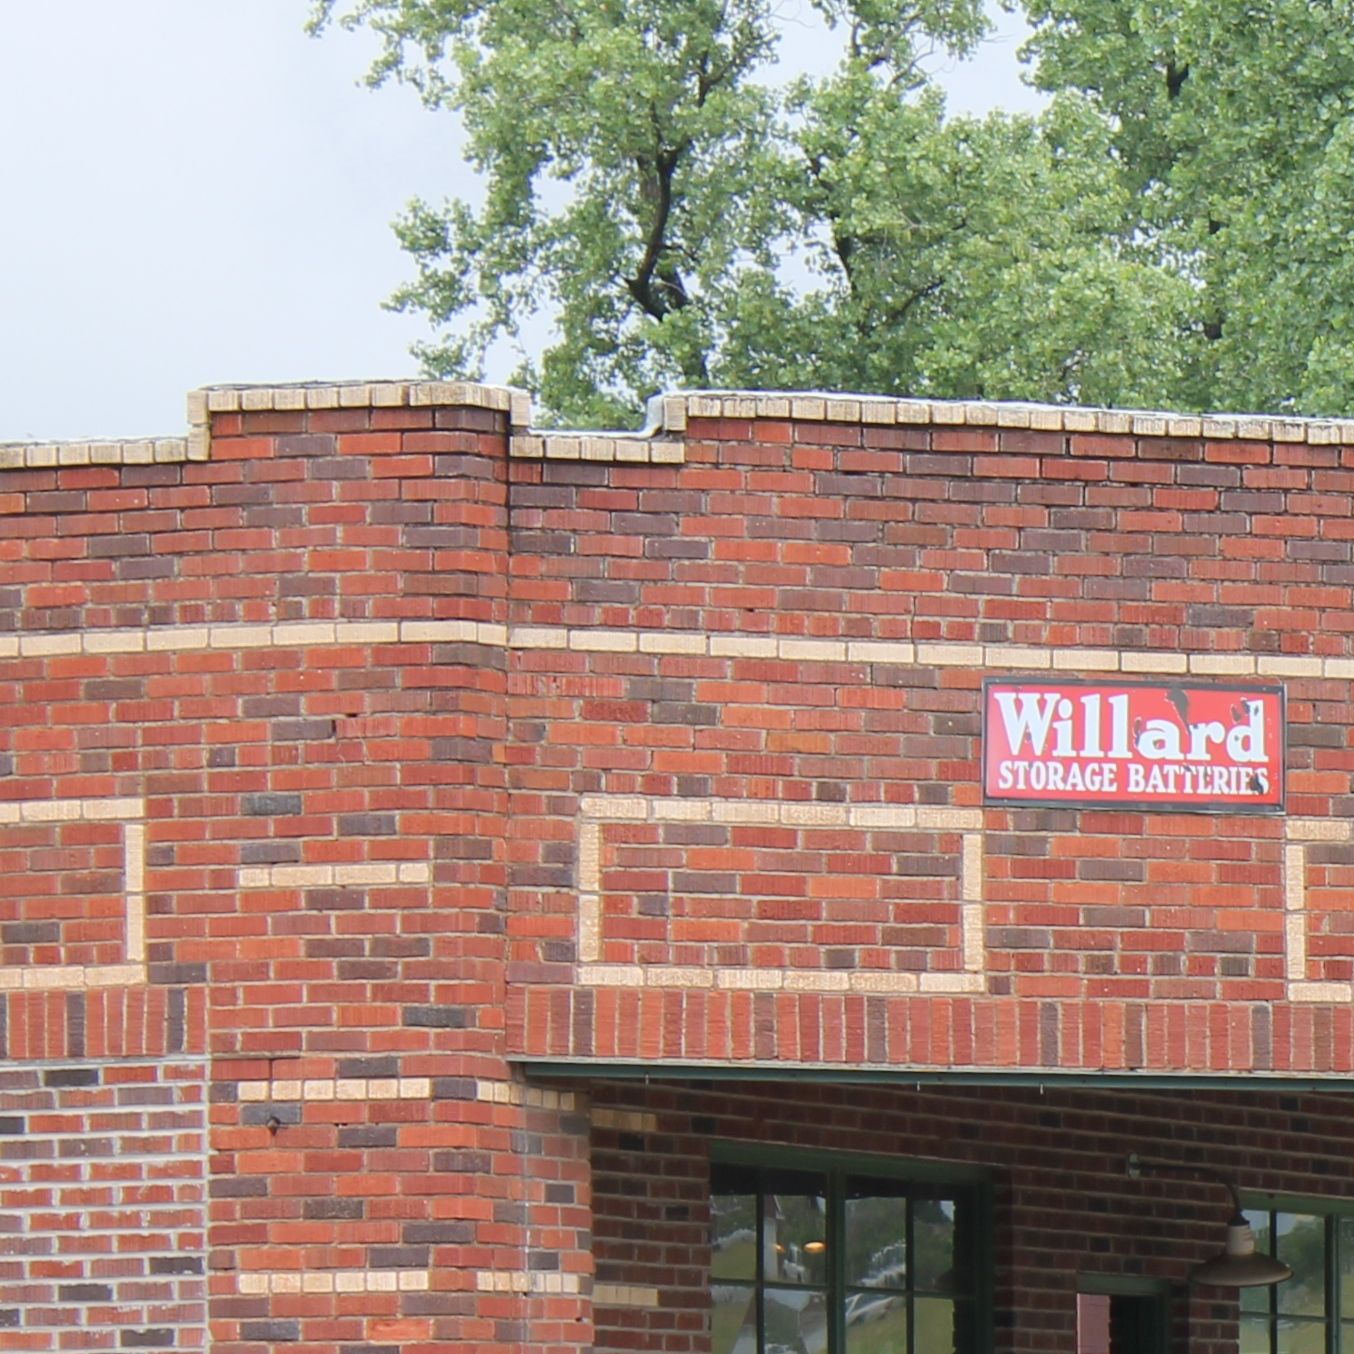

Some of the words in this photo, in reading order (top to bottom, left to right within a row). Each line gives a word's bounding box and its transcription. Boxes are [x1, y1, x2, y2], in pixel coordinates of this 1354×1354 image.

[993, 692, 1269, 763] Willard
[998, 760, 1117, 792] STORAGE
[1127, 763, 1269, 795] BATTERIES
